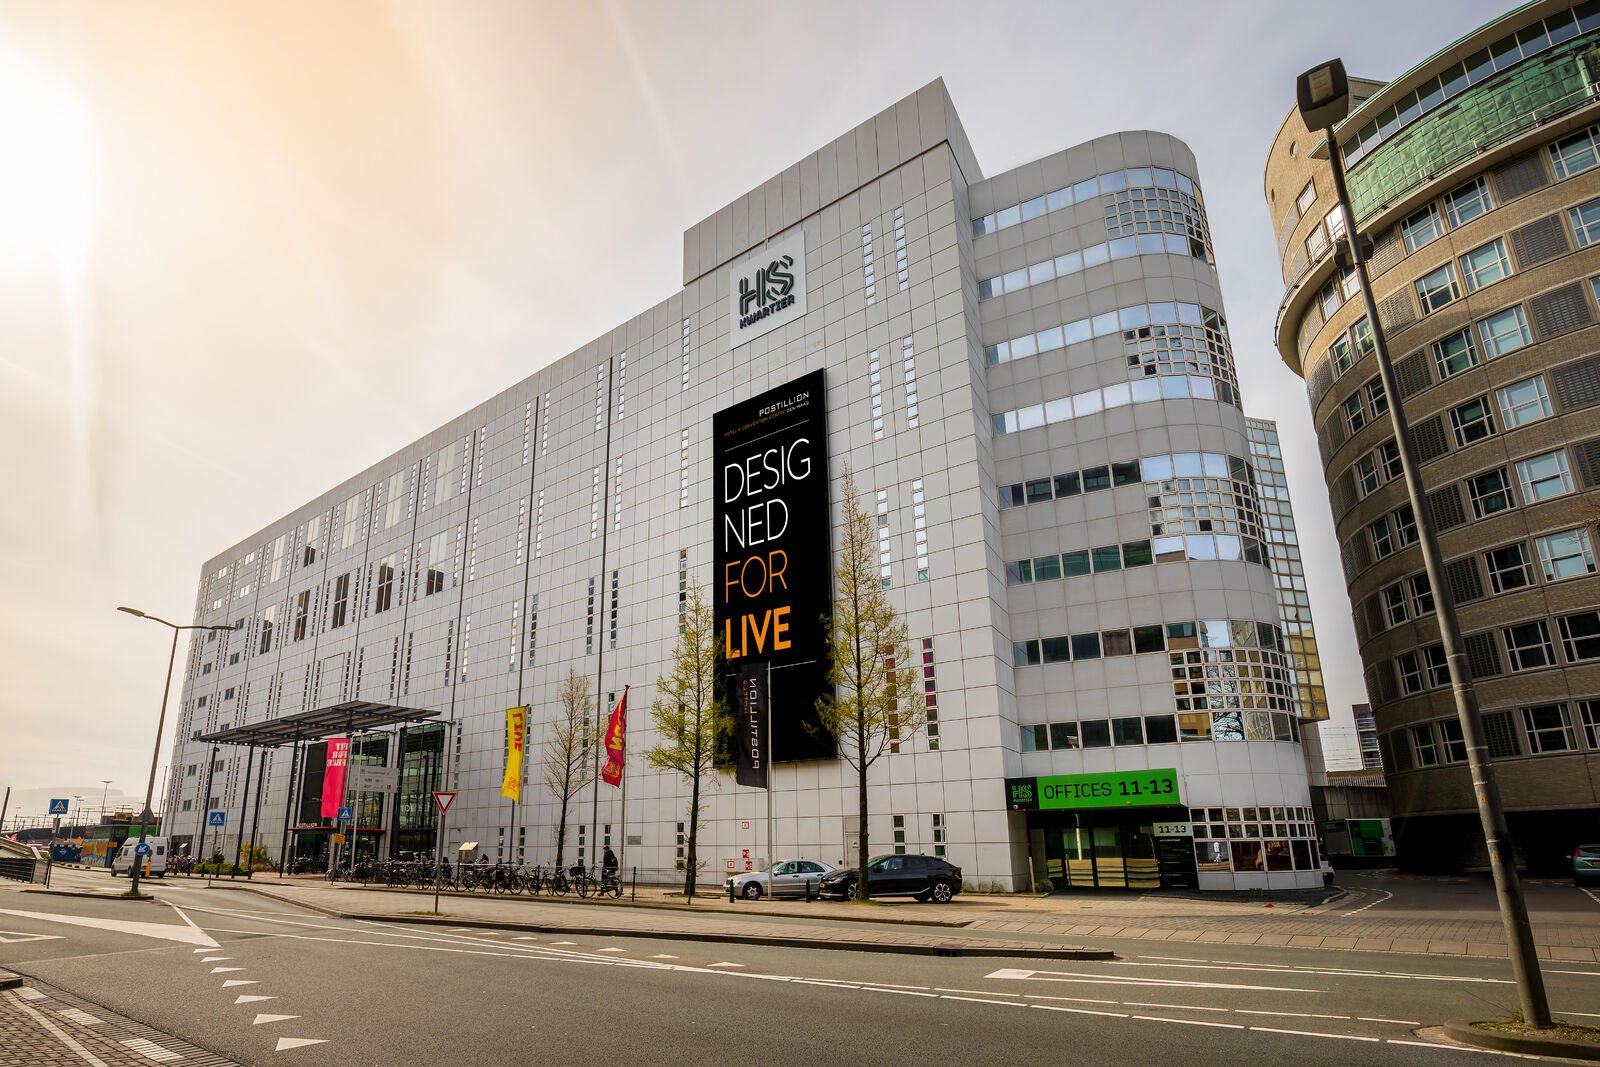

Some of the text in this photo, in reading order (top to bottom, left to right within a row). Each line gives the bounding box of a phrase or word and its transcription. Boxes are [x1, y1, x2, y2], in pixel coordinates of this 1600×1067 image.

[739, 255, 794, 316] HS
[739, 294, 795, 329] KWARTIER
[759, 391, 810, 417] POSTILLION
[725, 438, 811, 503] DESIG
[725, 499, 789, 553] NED
[725, 549, 788, 604] FOR
[725, 605, 792, 660] LIVE
[1043, 778, 1174, 799] OFFICES 11-13
[1158, 825, 1187, 834] 11-13
